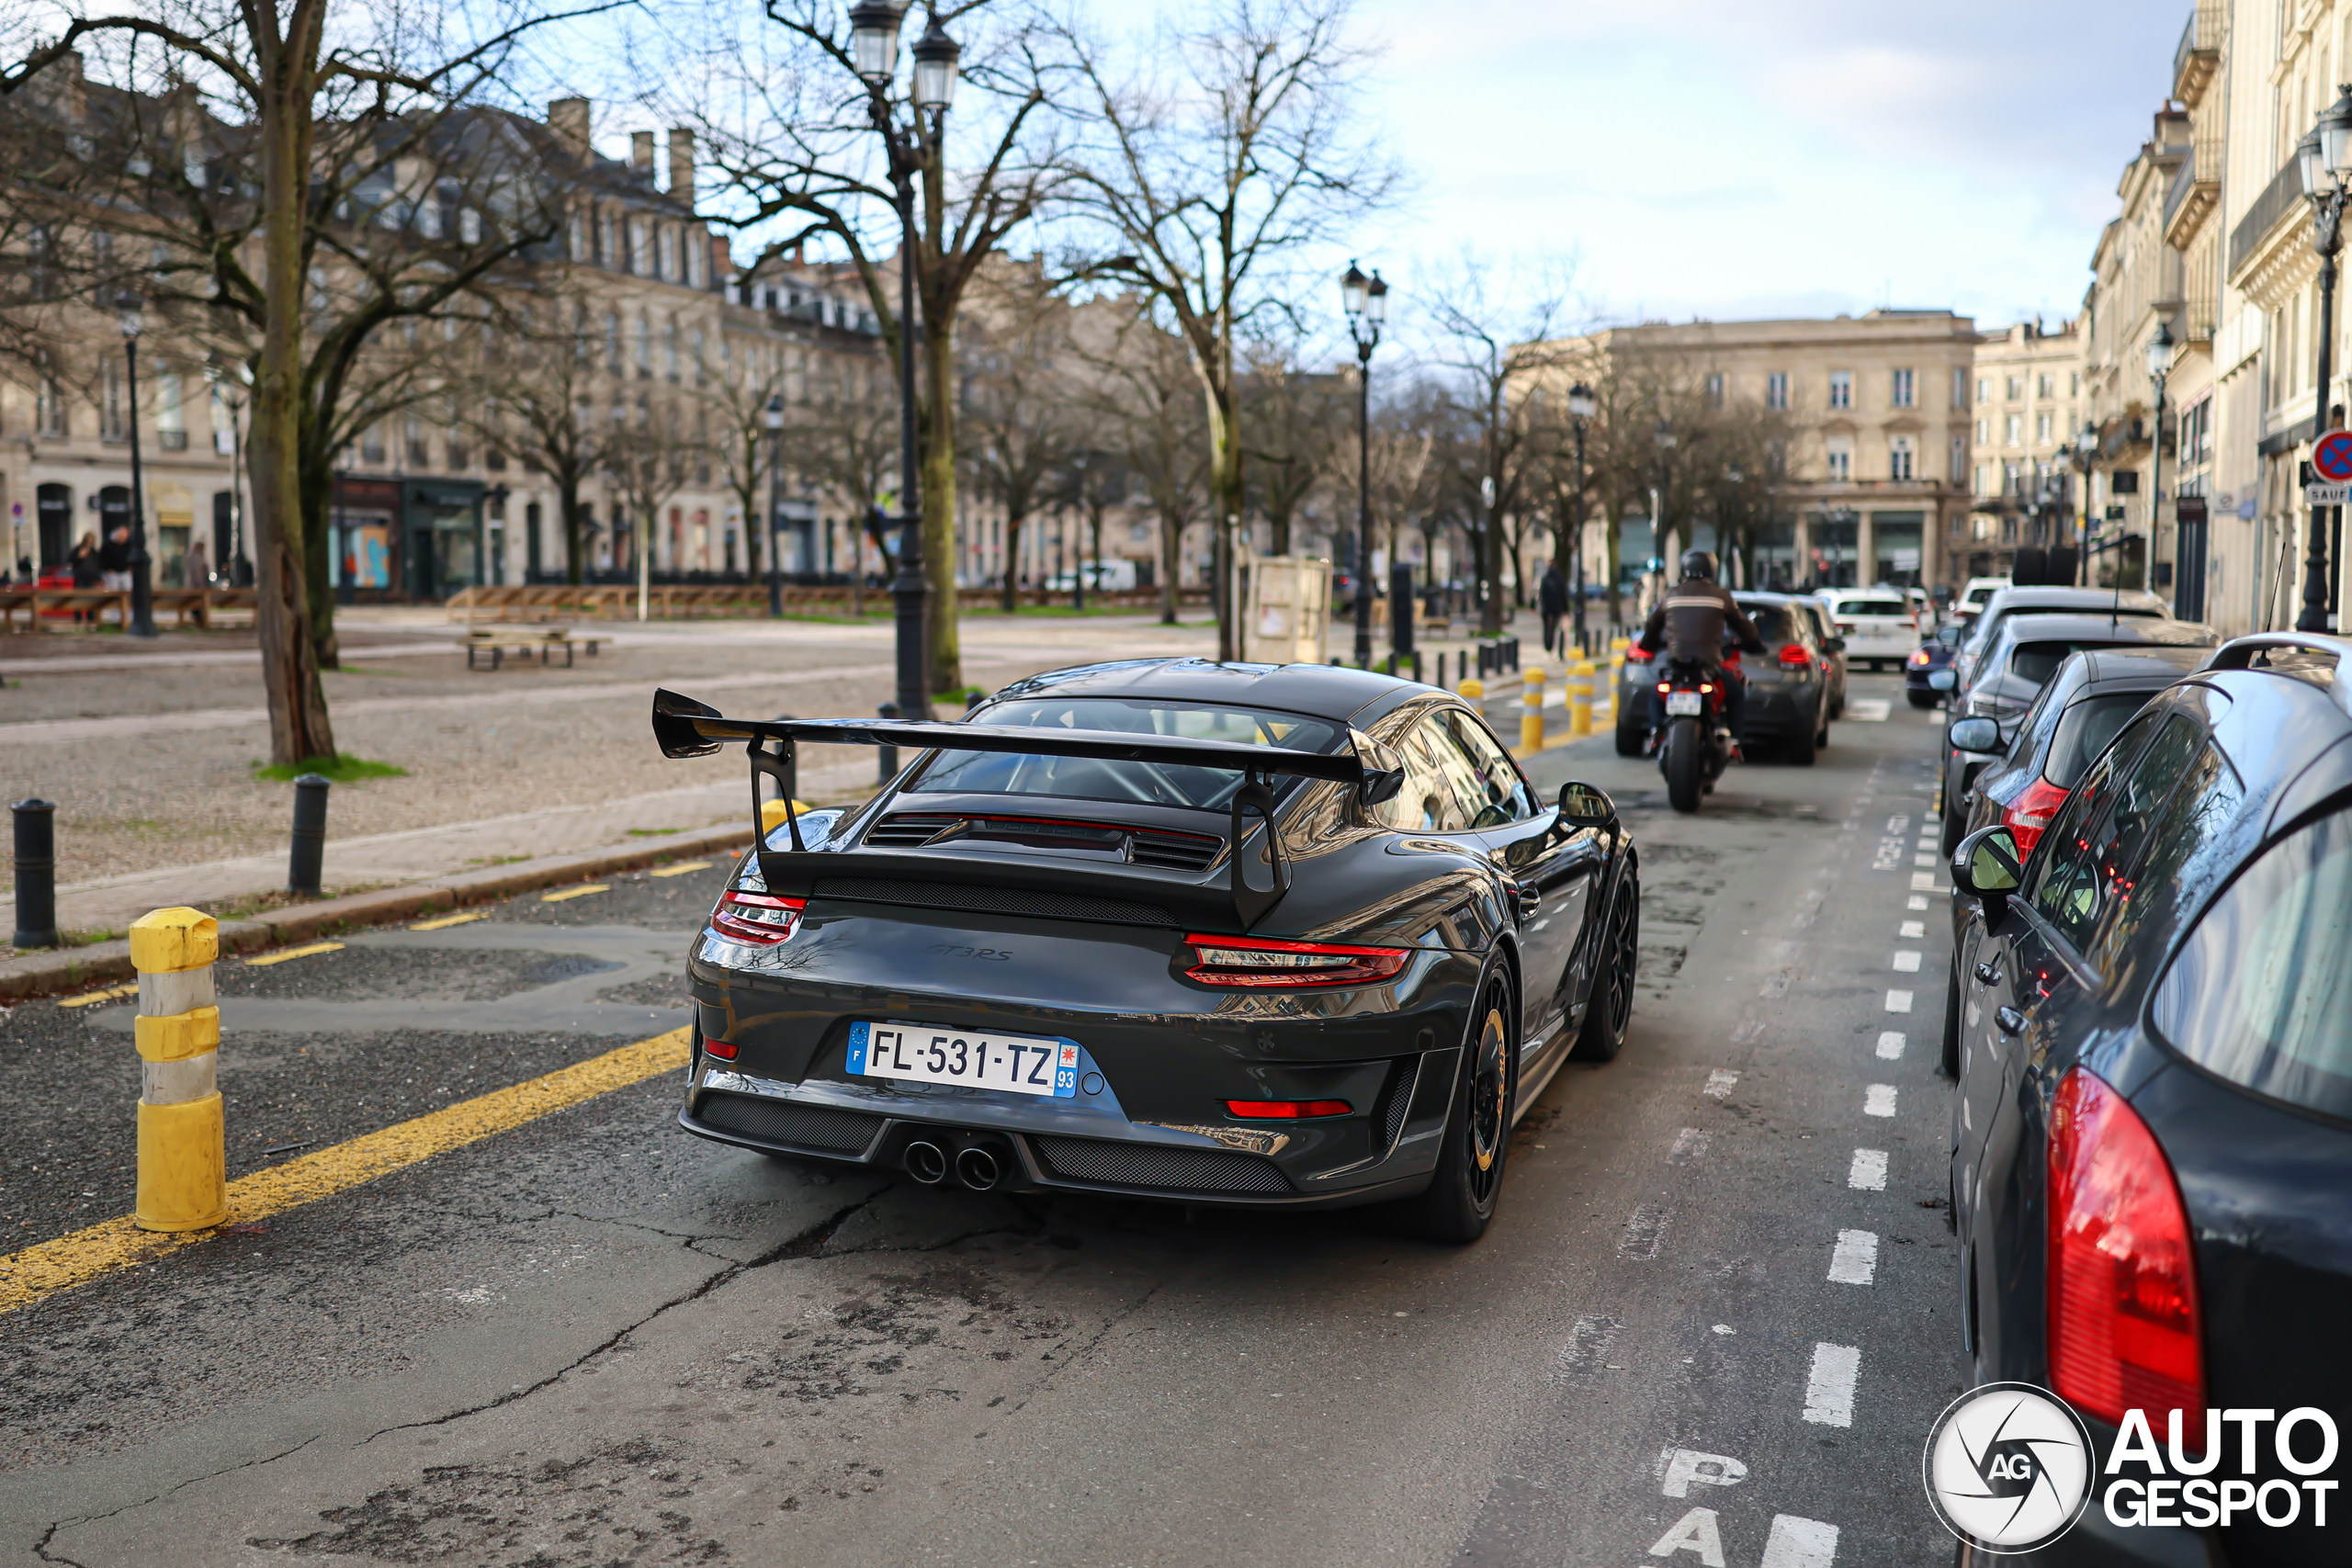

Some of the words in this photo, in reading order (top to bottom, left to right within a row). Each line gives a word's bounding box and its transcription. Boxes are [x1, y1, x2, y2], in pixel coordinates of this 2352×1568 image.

[2312, 489, 2346, 502] SAUF
[853, 1050, 861, 1061] F
[872, 1031, 1052, 1086] FL-531-TZ
[1057, 1070, 1075, 1089] 93
